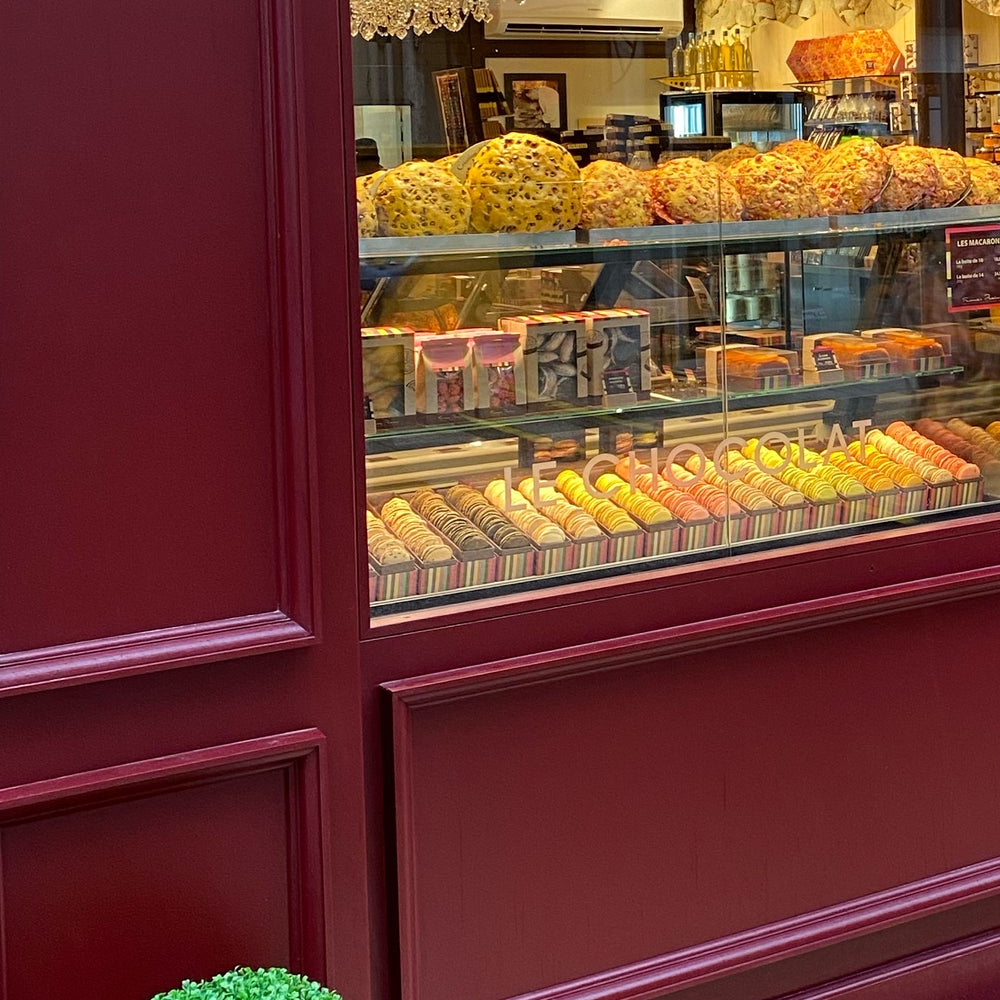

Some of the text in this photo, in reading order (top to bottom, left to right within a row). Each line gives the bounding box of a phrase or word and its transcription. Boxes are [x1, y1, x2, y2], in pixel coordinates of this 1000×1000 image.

[956, 239, 968, 247] LES
[504, 419, 873, 512] LE CHOCOLAT
